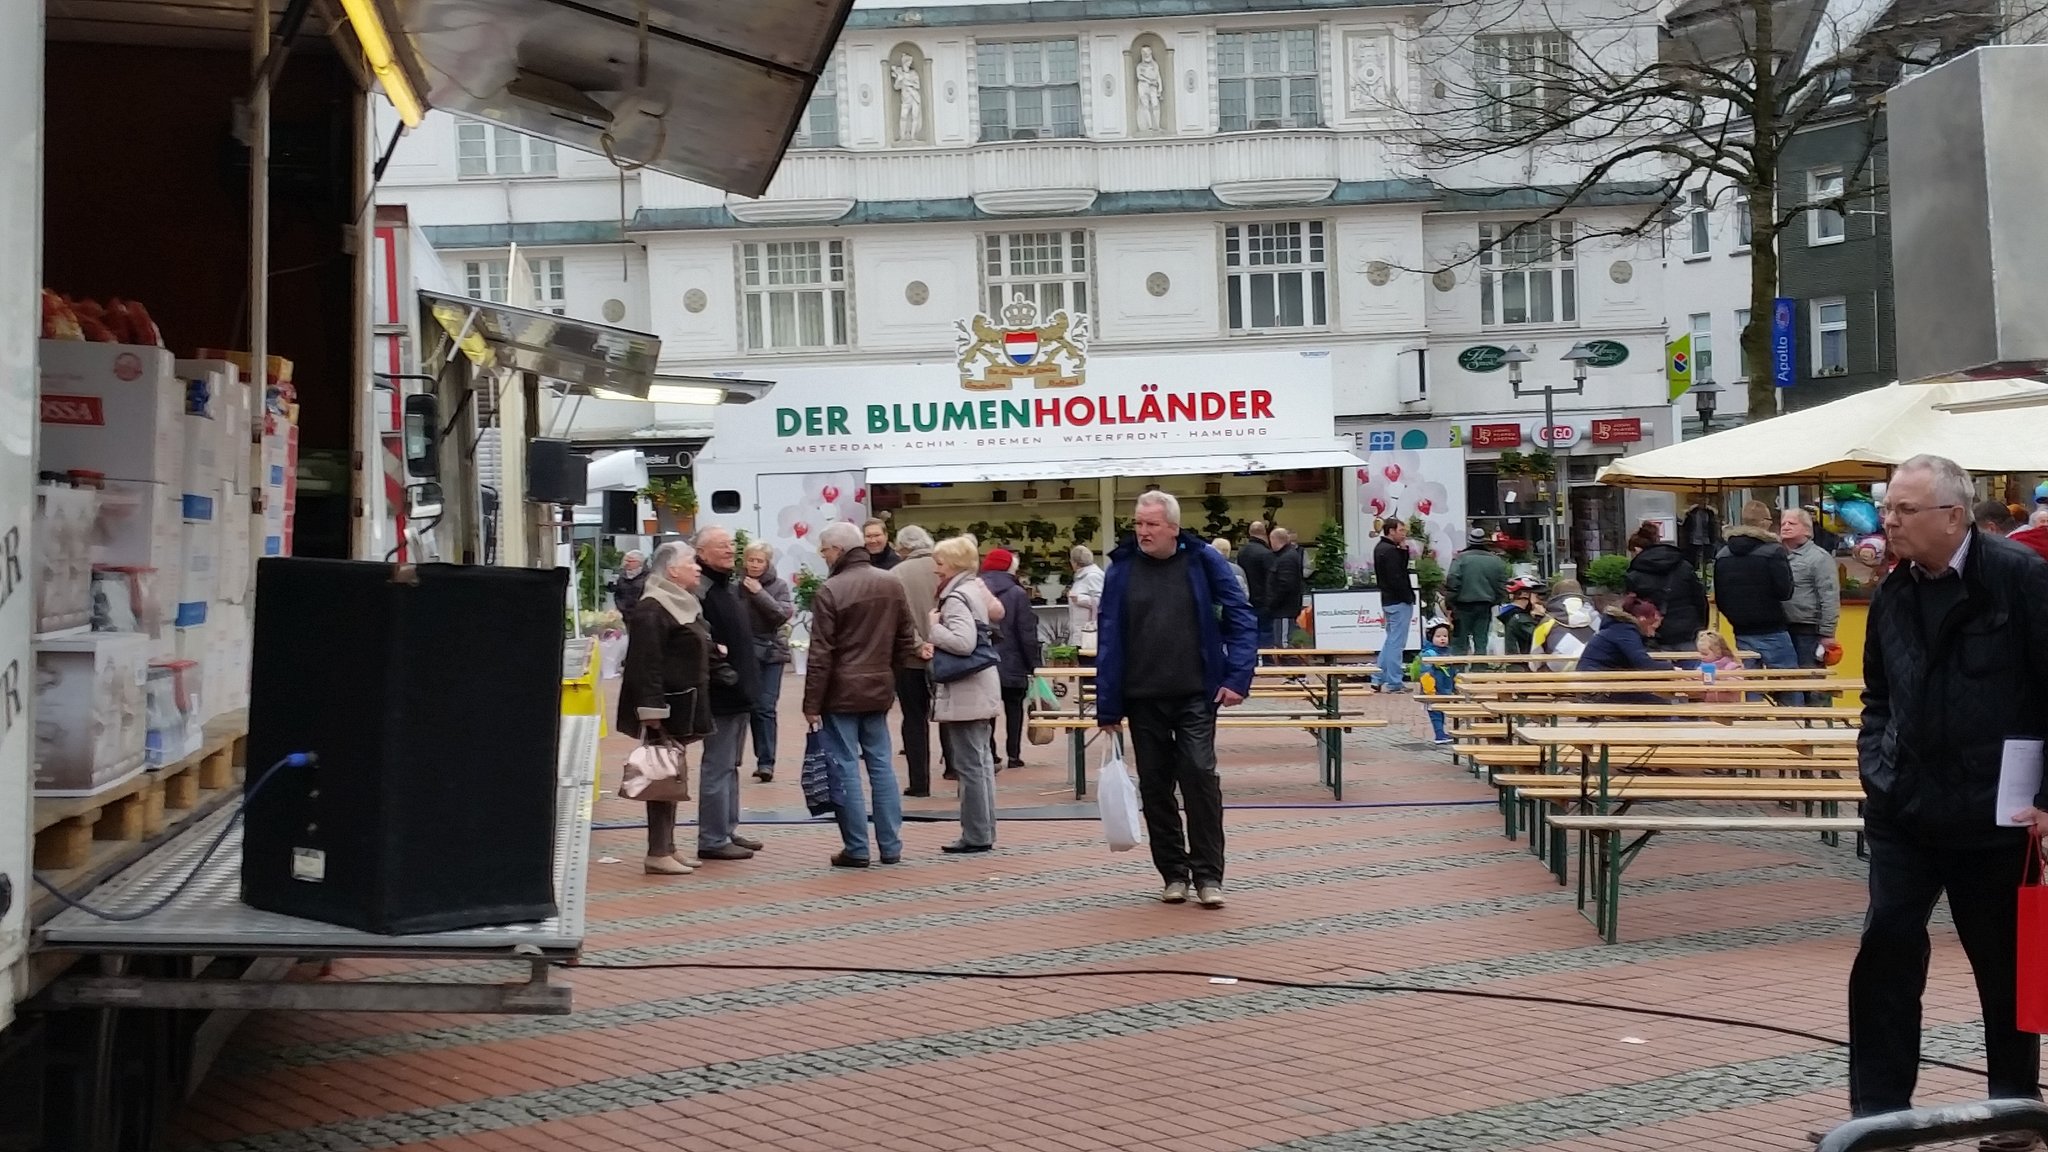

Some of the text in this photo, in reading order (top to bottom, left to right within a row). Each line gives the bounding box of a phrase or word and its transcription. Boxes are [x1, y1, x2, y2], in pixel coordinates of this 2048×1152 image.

[1776, 336, 1791, 381] Apollo
[776, 384, 1275, 437] DER BLUMENHOLLÄNDER
[785, 427, 1268, 453] AMSTERDAM ACHIM BREMEN WATERFRONT HAMBURG
[1541, 427, 1573, 440] CGO
